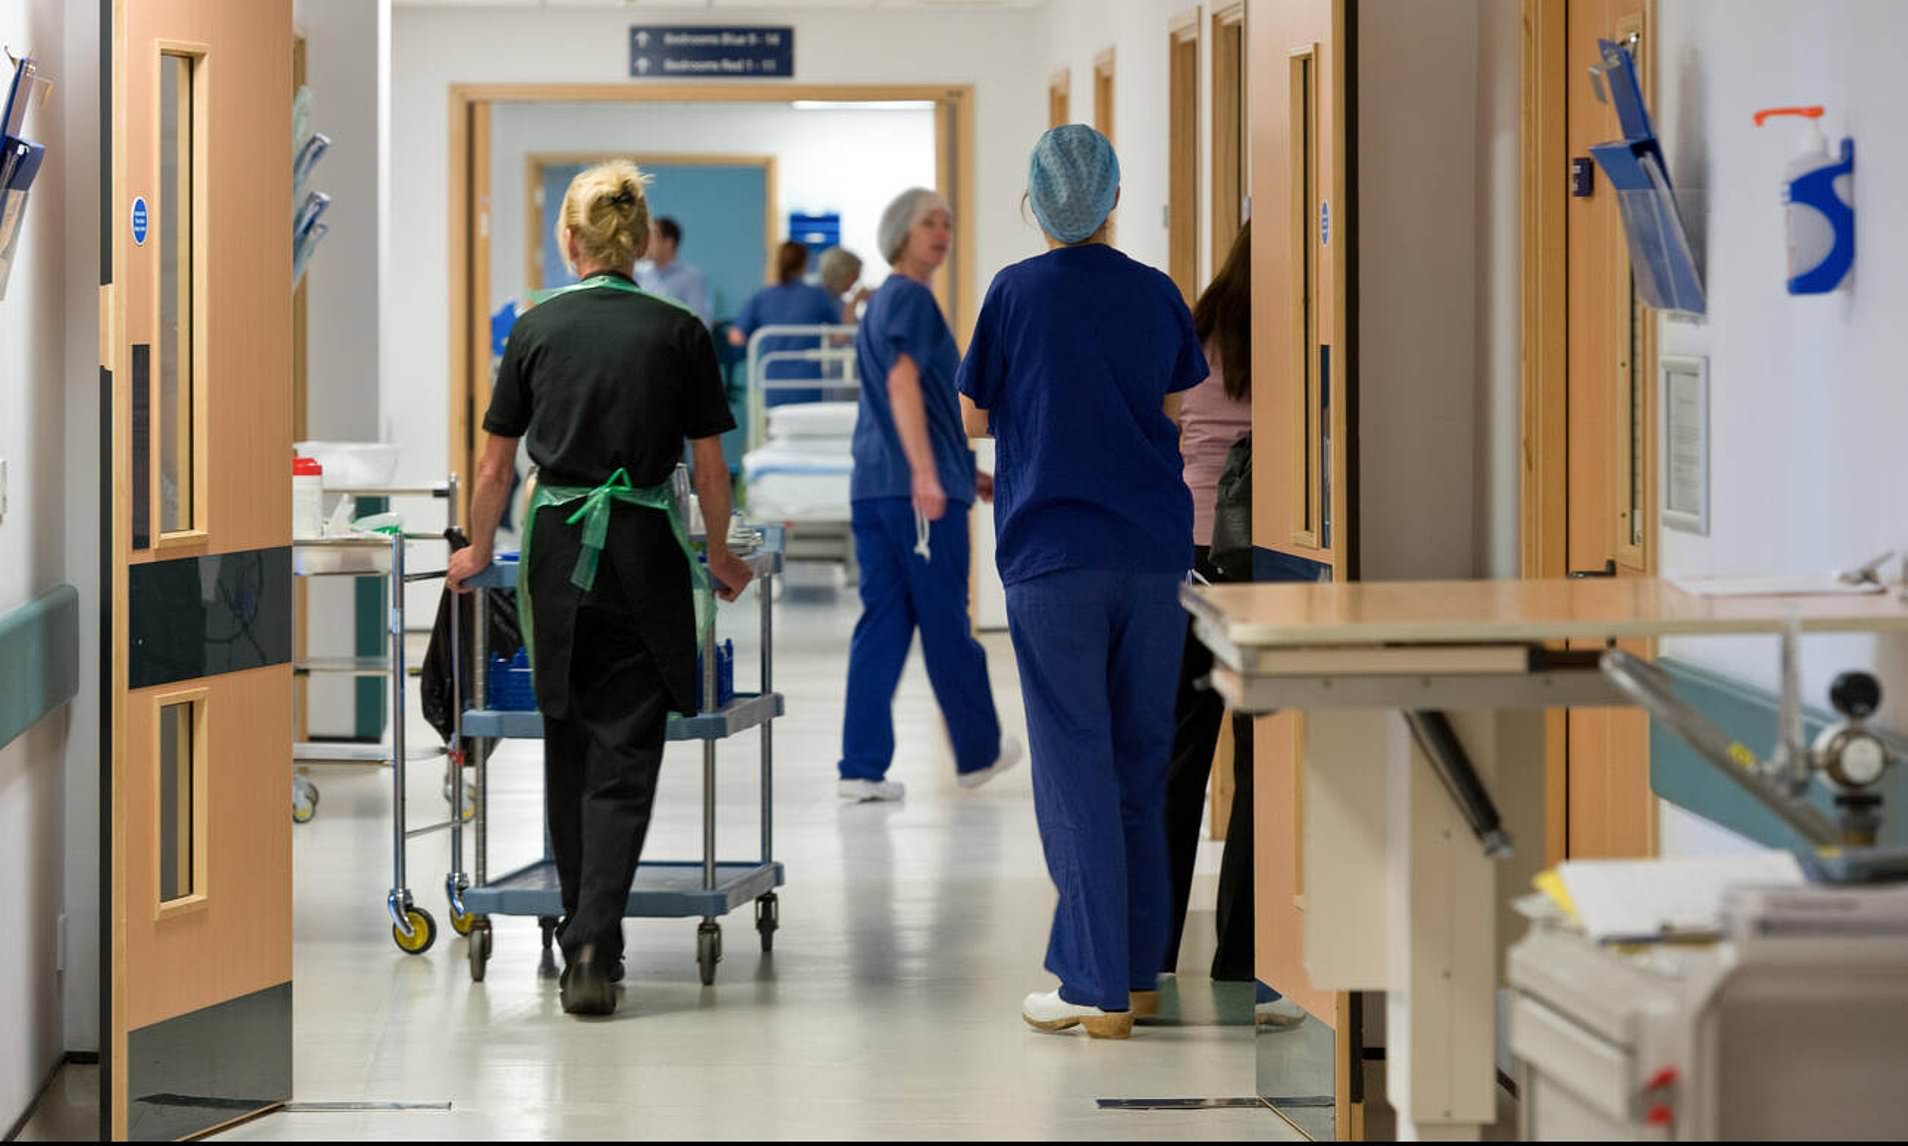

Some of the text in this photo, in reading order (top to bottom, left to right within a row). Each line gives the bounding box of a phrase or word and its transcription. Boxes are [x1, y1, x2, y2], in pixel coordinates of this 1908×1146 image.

[663, 33, 719, 46] Bedrooms
[663, 59, 719, 72] Bedrooms
[721, 59, 744, 72] Red
